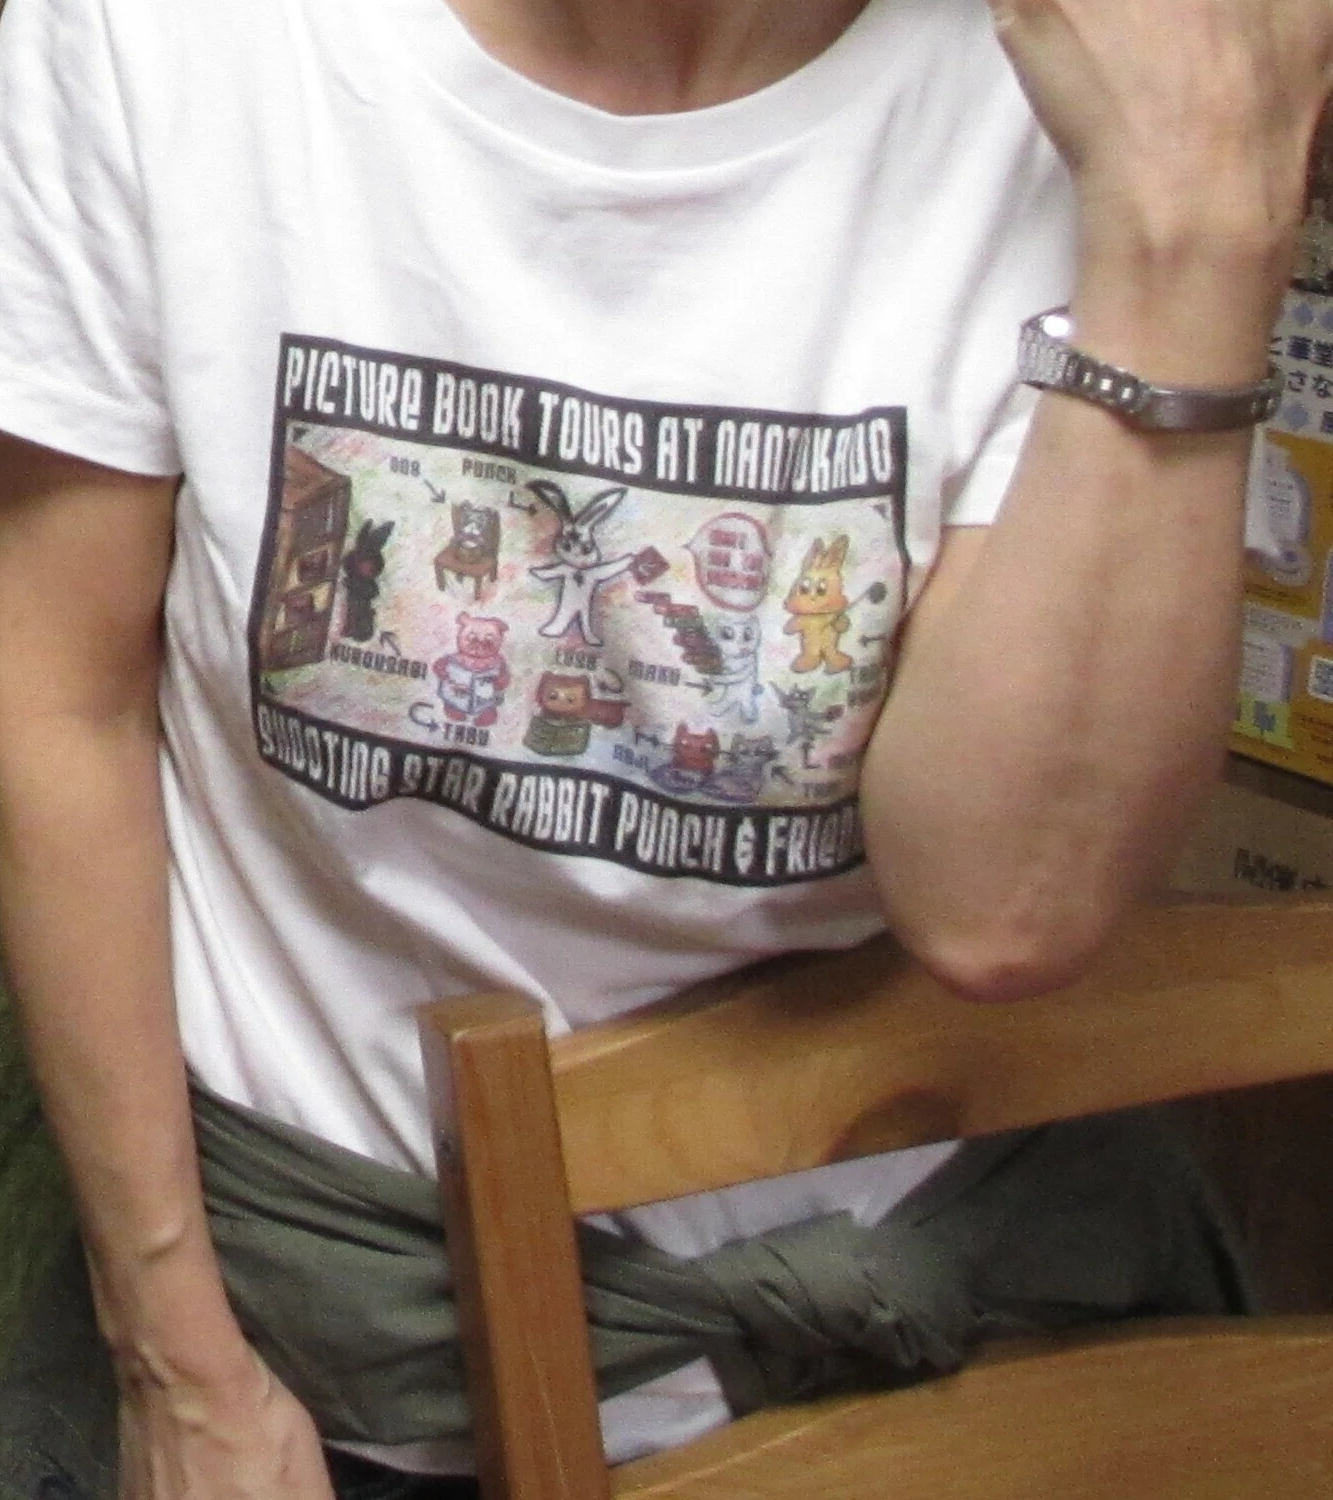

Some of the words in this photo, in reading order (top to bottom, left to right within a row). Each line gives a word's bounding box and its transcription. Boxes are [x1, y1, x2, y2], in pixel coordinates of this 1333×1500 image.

[283, 345, 423, 432] PICTURE
[431, 372, 526, 450] BOOK
[536, 390, 644, 476] TOURS
[656, 415, 704, 484] AT
[258, 702, 393, 802] SHOOTING
[400, 752, 487, 814] STAR
[488, 773, 611, 846] RABBIT
[614, 791, 727, 874] PUNCH
